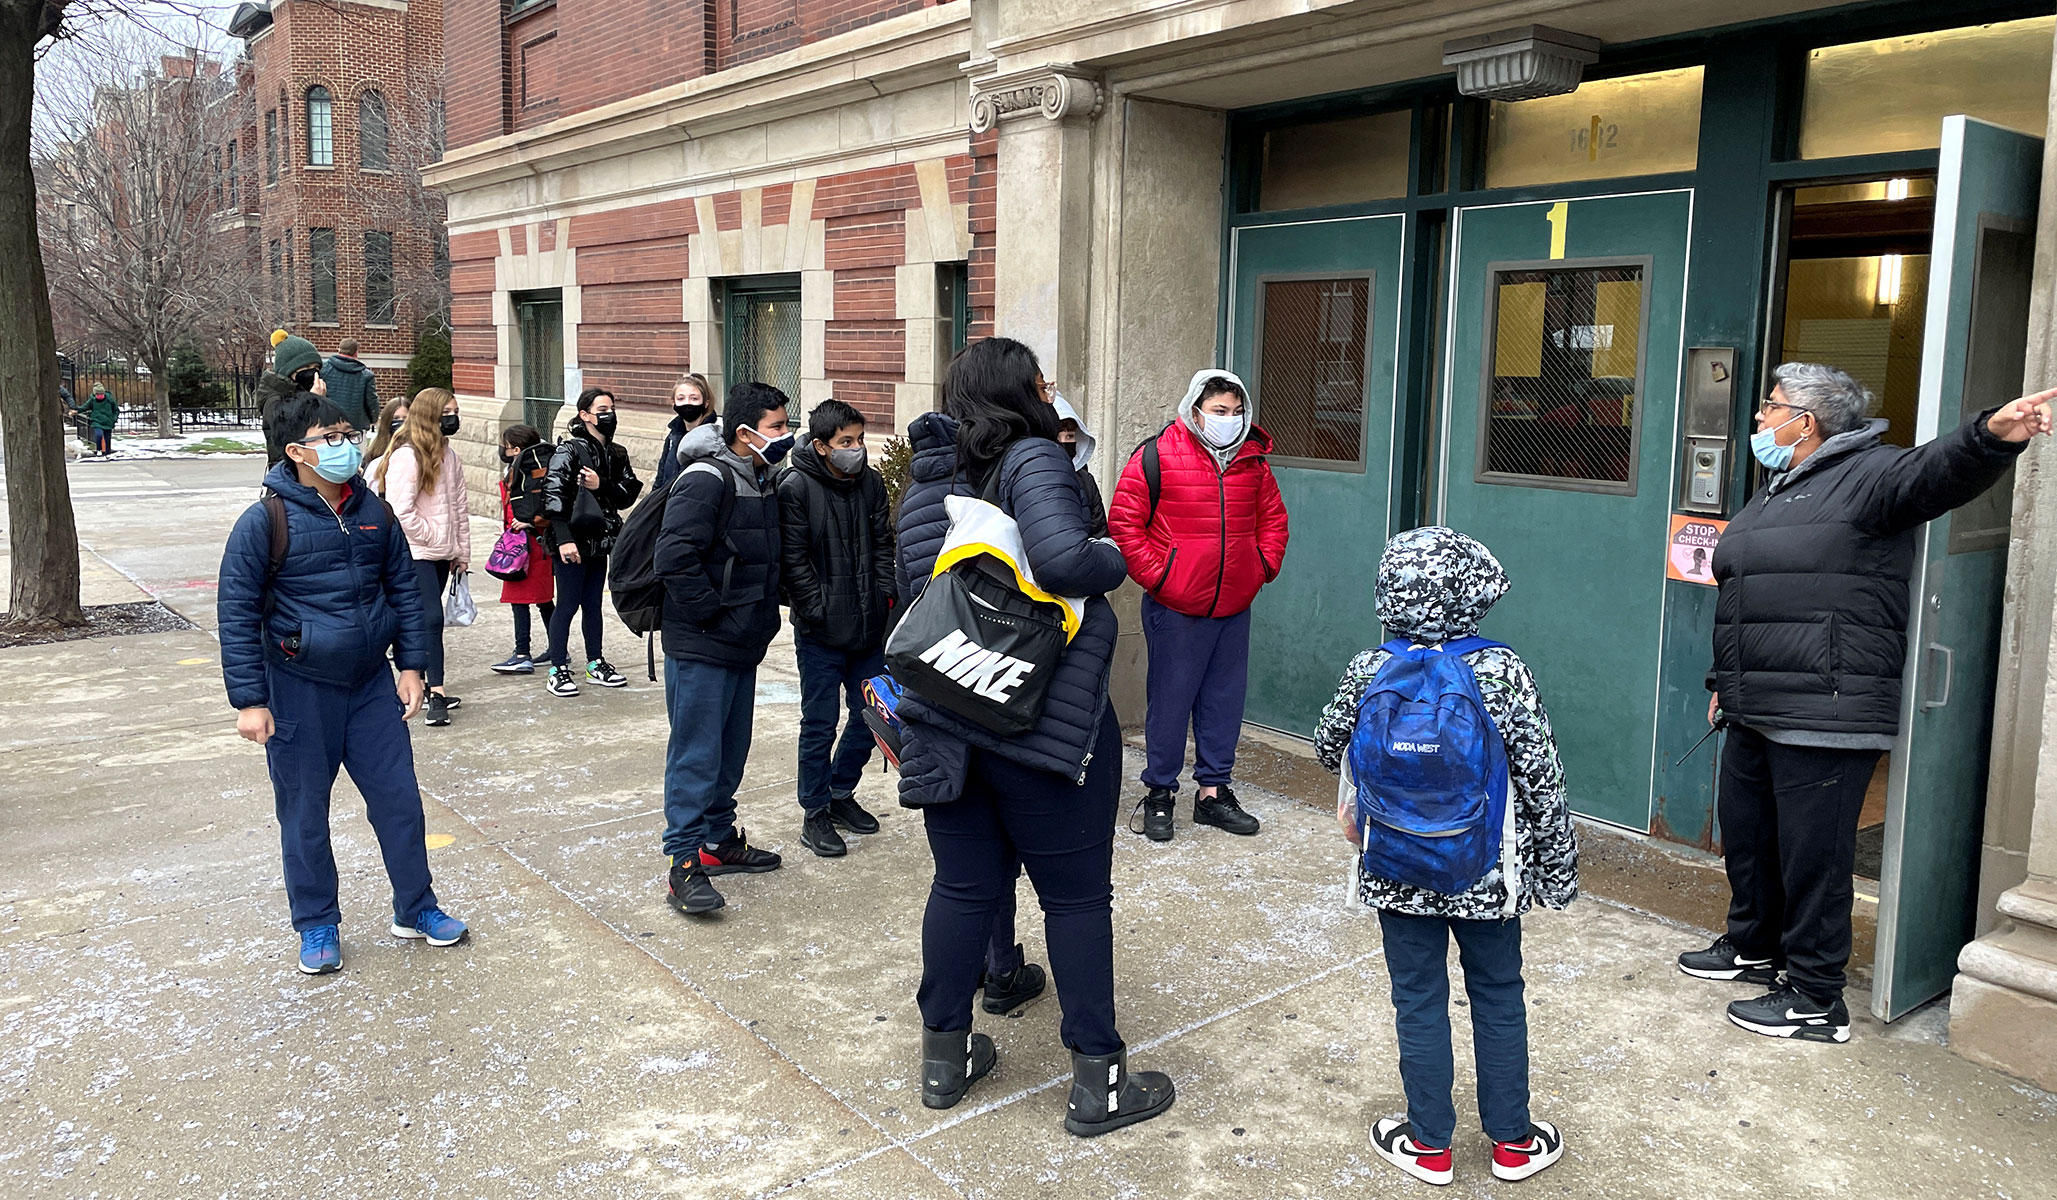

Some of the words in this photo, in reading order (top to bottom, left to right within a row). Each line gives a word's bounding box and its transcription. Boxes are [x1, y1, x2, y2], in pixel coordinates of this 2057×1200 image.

[1546, 201, 1569, 260] 1
[1686, 524, 1716, 536] STOP
[918, 628, 1036, 704] NIKE
[1393, 742, 1416, 752] MODA
[1417, 744, 1440, 753] WEST
